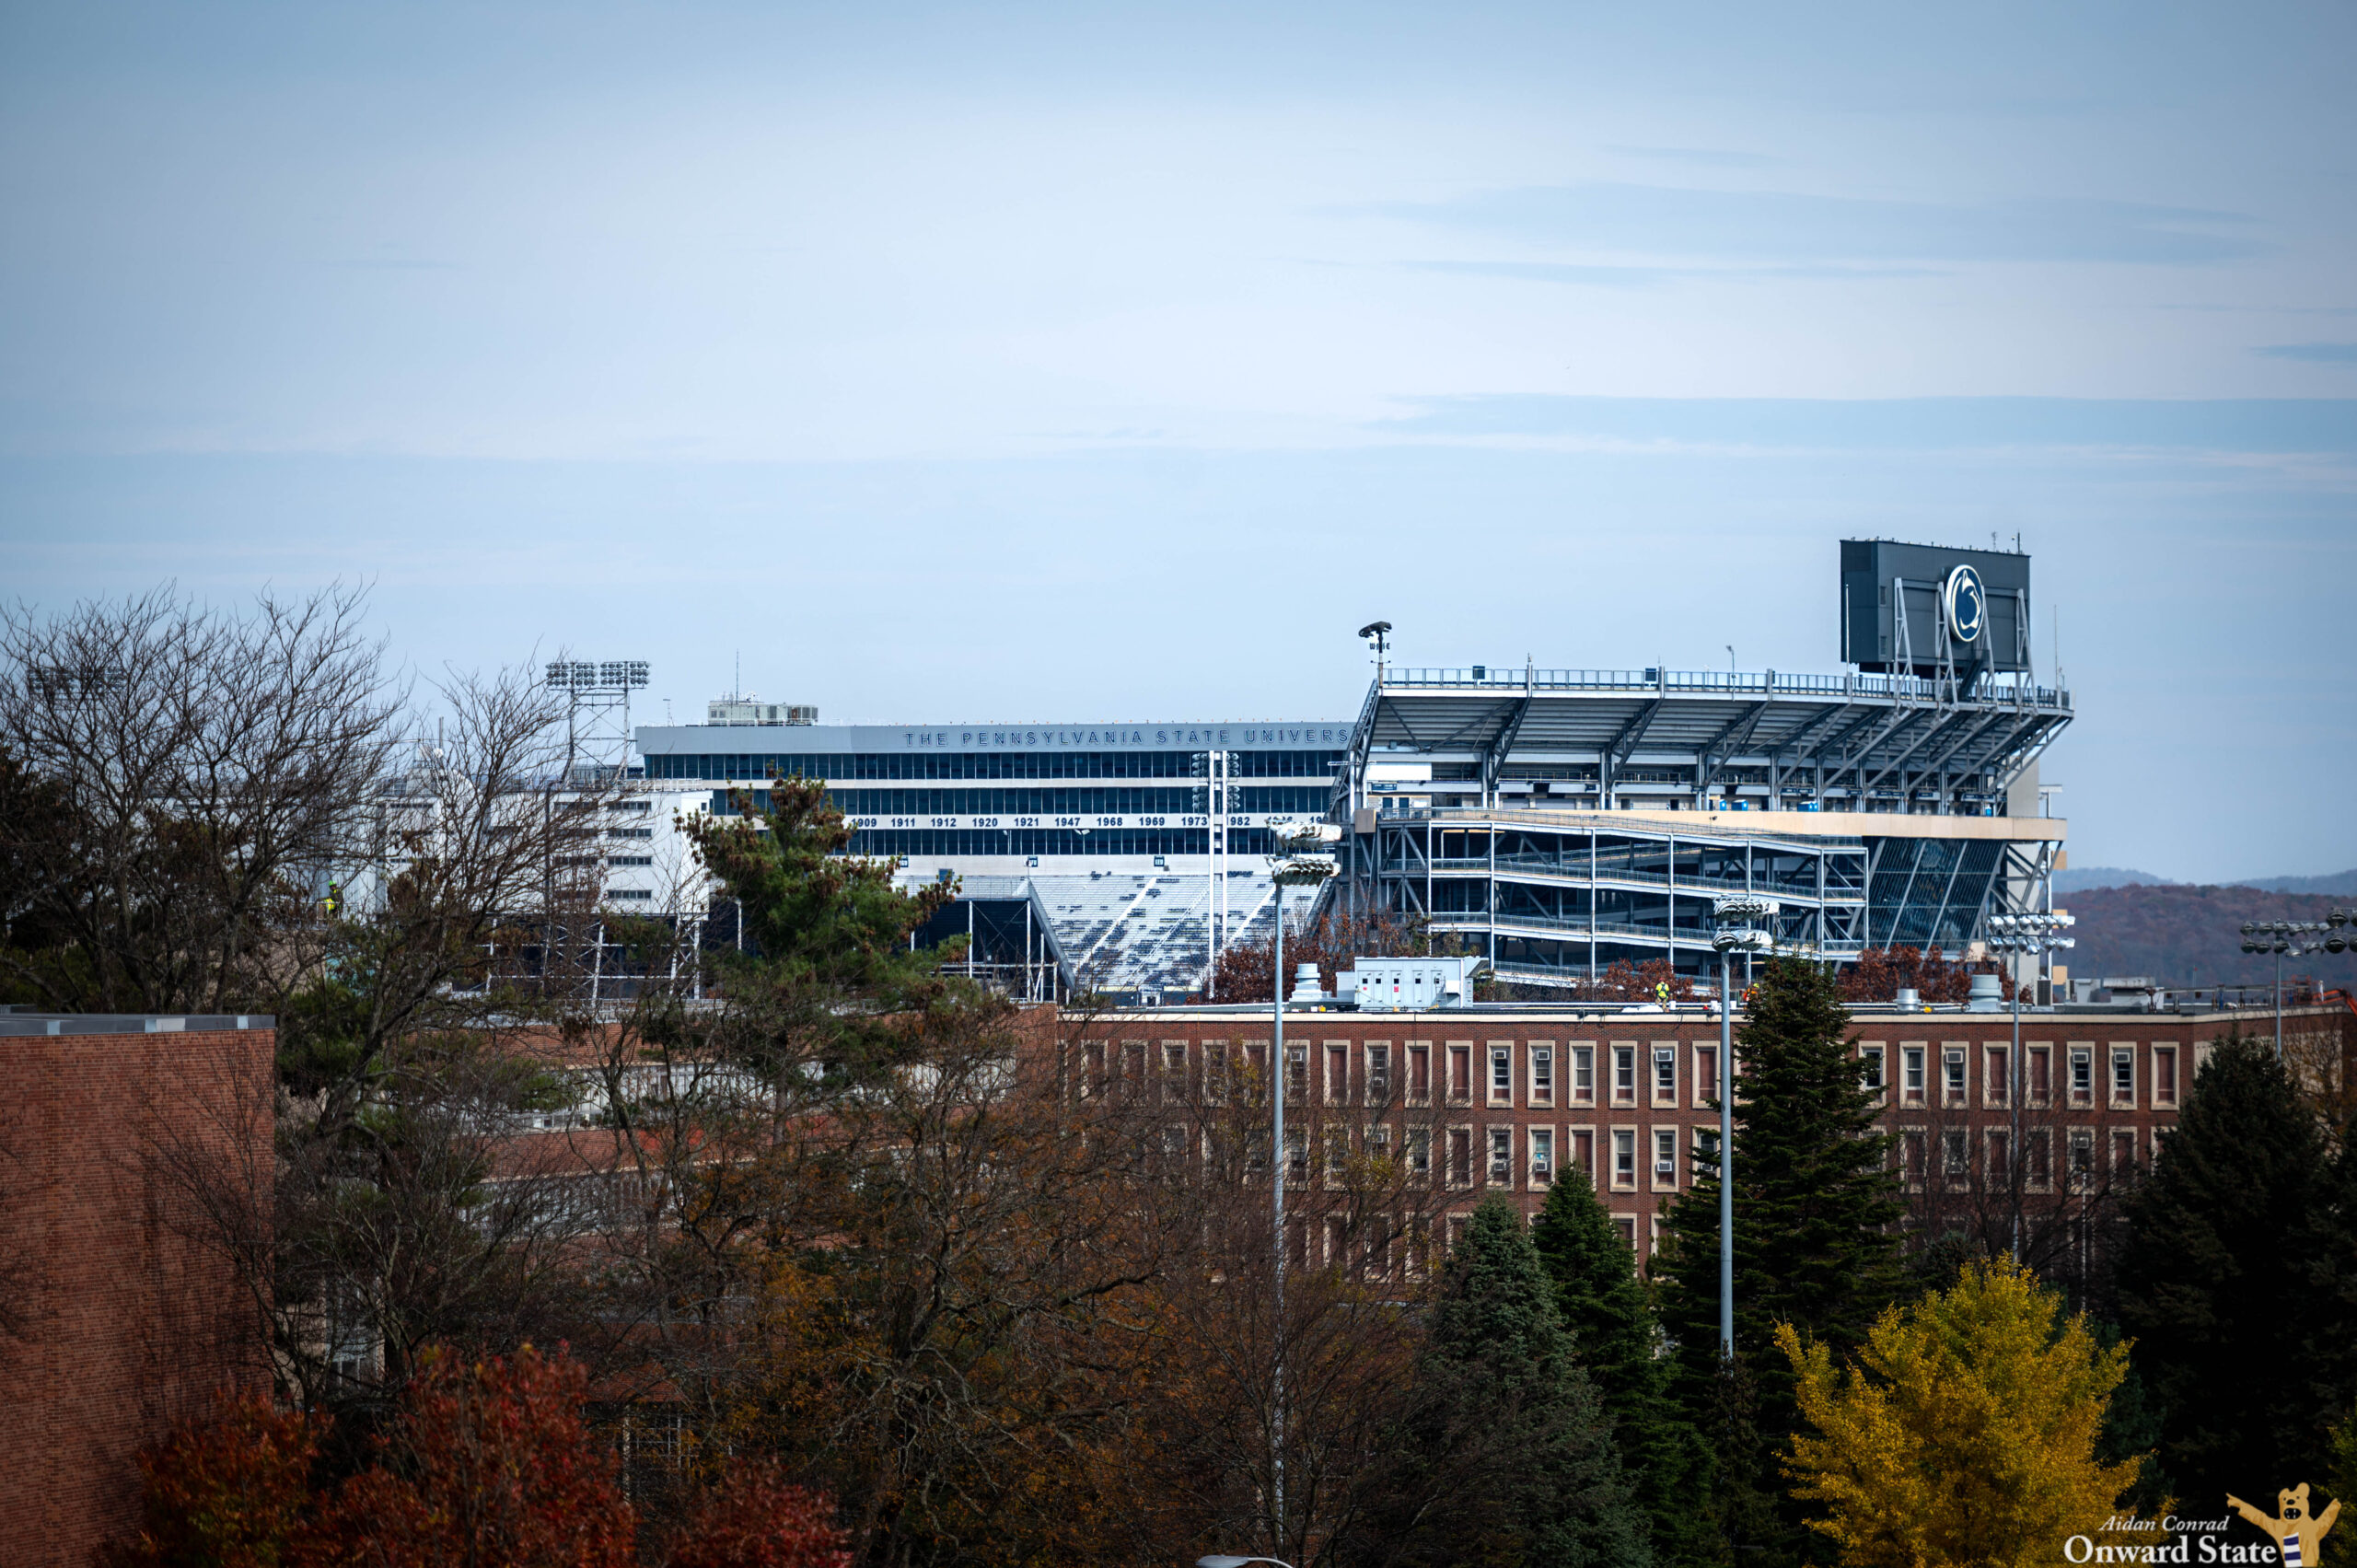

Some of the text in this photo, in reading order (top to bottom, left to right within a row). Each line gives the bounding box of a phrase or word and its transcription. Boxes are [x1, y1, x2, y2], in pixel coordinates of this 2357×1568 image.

[905, 732, 947, 747] THE
[962, 730, 1143, 746] PENNSYLVANIA
[1156, 729, 1230, 745] STATE
[851, 818, 877, 828] 1909
[890, 818, 916, 828] 1911
[930, 818, 957, 828] 1912
[971, 818, 999, 828] 1920
[1014, 817, 1039, 827] 1921
[1054, 817, 1081, 827] 1947
[1097, 817, 1123, 827] 1968
[1139, 817, 1166, 827] 1969
[1181, 817, 1208, 827] 1973
